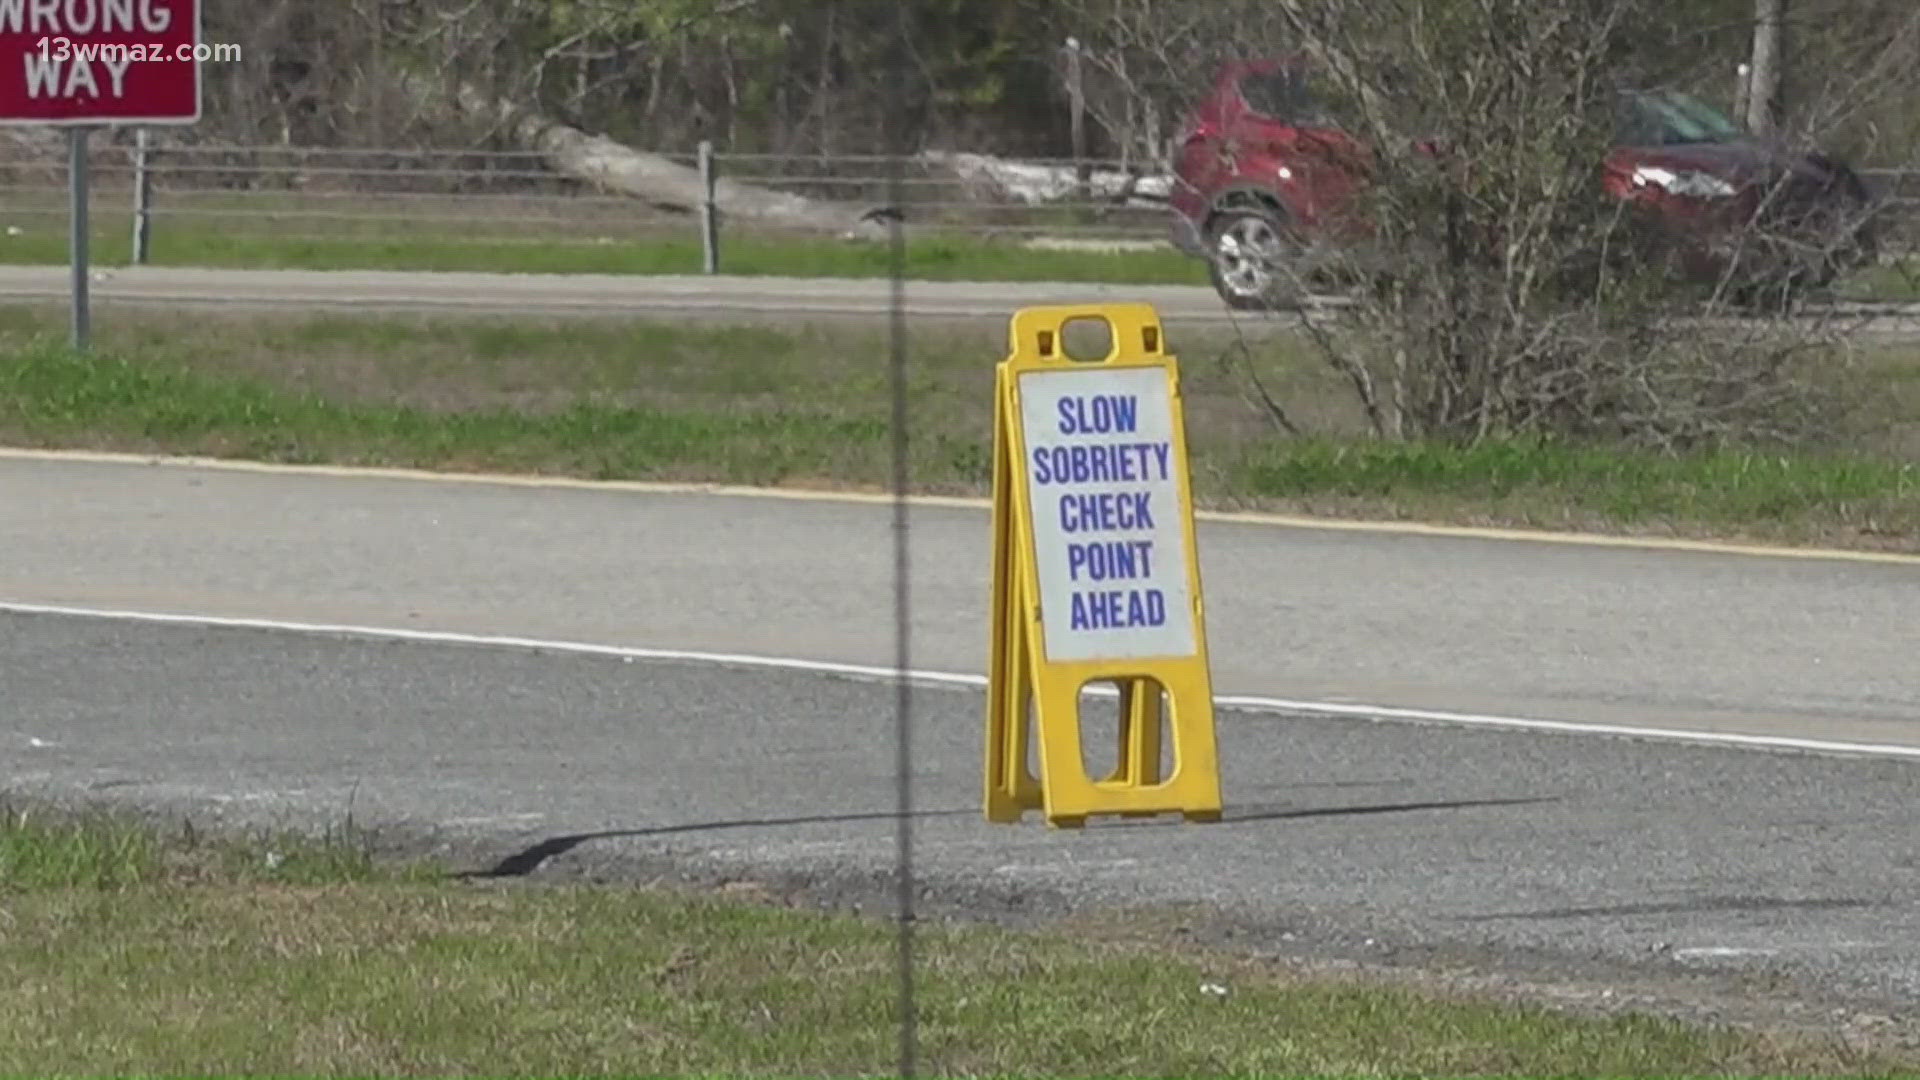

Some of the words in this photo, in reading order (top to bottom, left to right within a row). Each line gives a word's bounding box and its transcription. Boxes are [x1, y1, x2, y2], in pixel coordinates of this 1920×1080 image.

[23, 51, 132, 98] WAY
[1057, 395, 1137, 435] SLOW
[1033, 443, 1168, 484] SOBRIETY
[1059, 491, 1154, 533] CHECK
[1068, 541, 1153, 581] POINT
[1071, 589, 1166, 630] AHEAD
